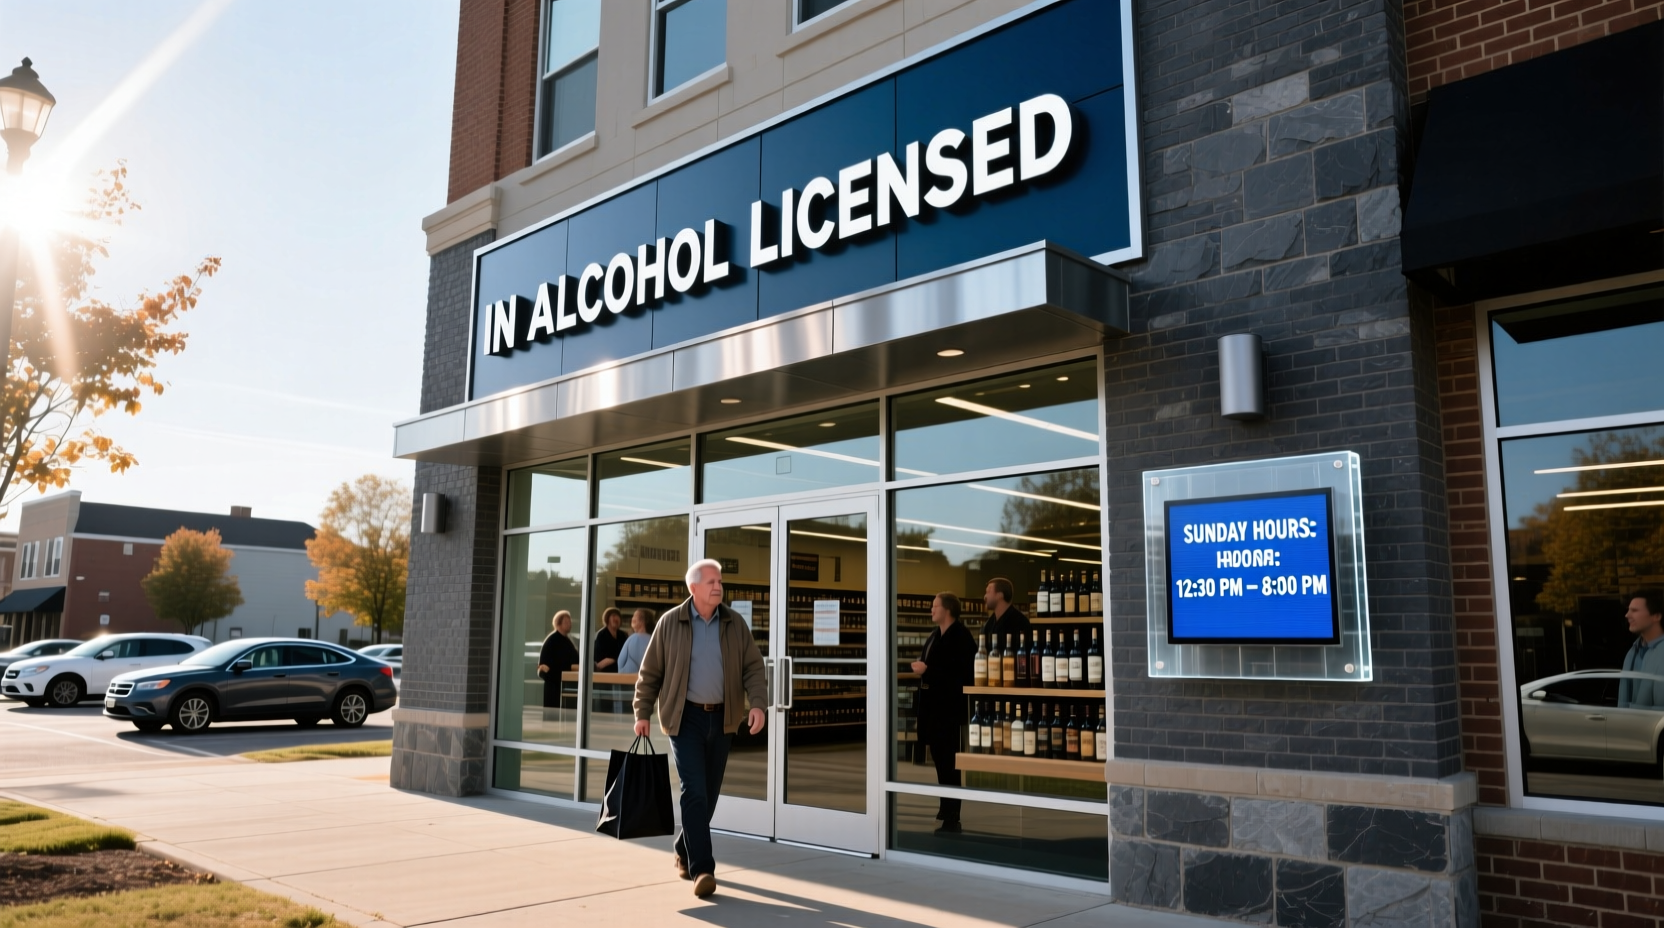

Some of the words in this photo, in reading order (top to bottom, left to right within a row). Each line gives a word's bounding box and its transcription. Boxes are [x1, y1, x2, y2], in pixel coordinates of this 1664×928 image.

[483, 295, 516, 356] IN
[527, 218, 730, 342] ALCOHOL
[749, 93, 1073, 268] LICENSED
[1183, 521, 1248, 544] SUNDAY
[1253, 517, 1317, 540] HOURS:
[1176, 578, 1216, 598] 12:30
[1219, 578, 1243, 597] PM
[1261, 575, 1298, 596] 8:00
[1301, 574, 1328, 595] PM
